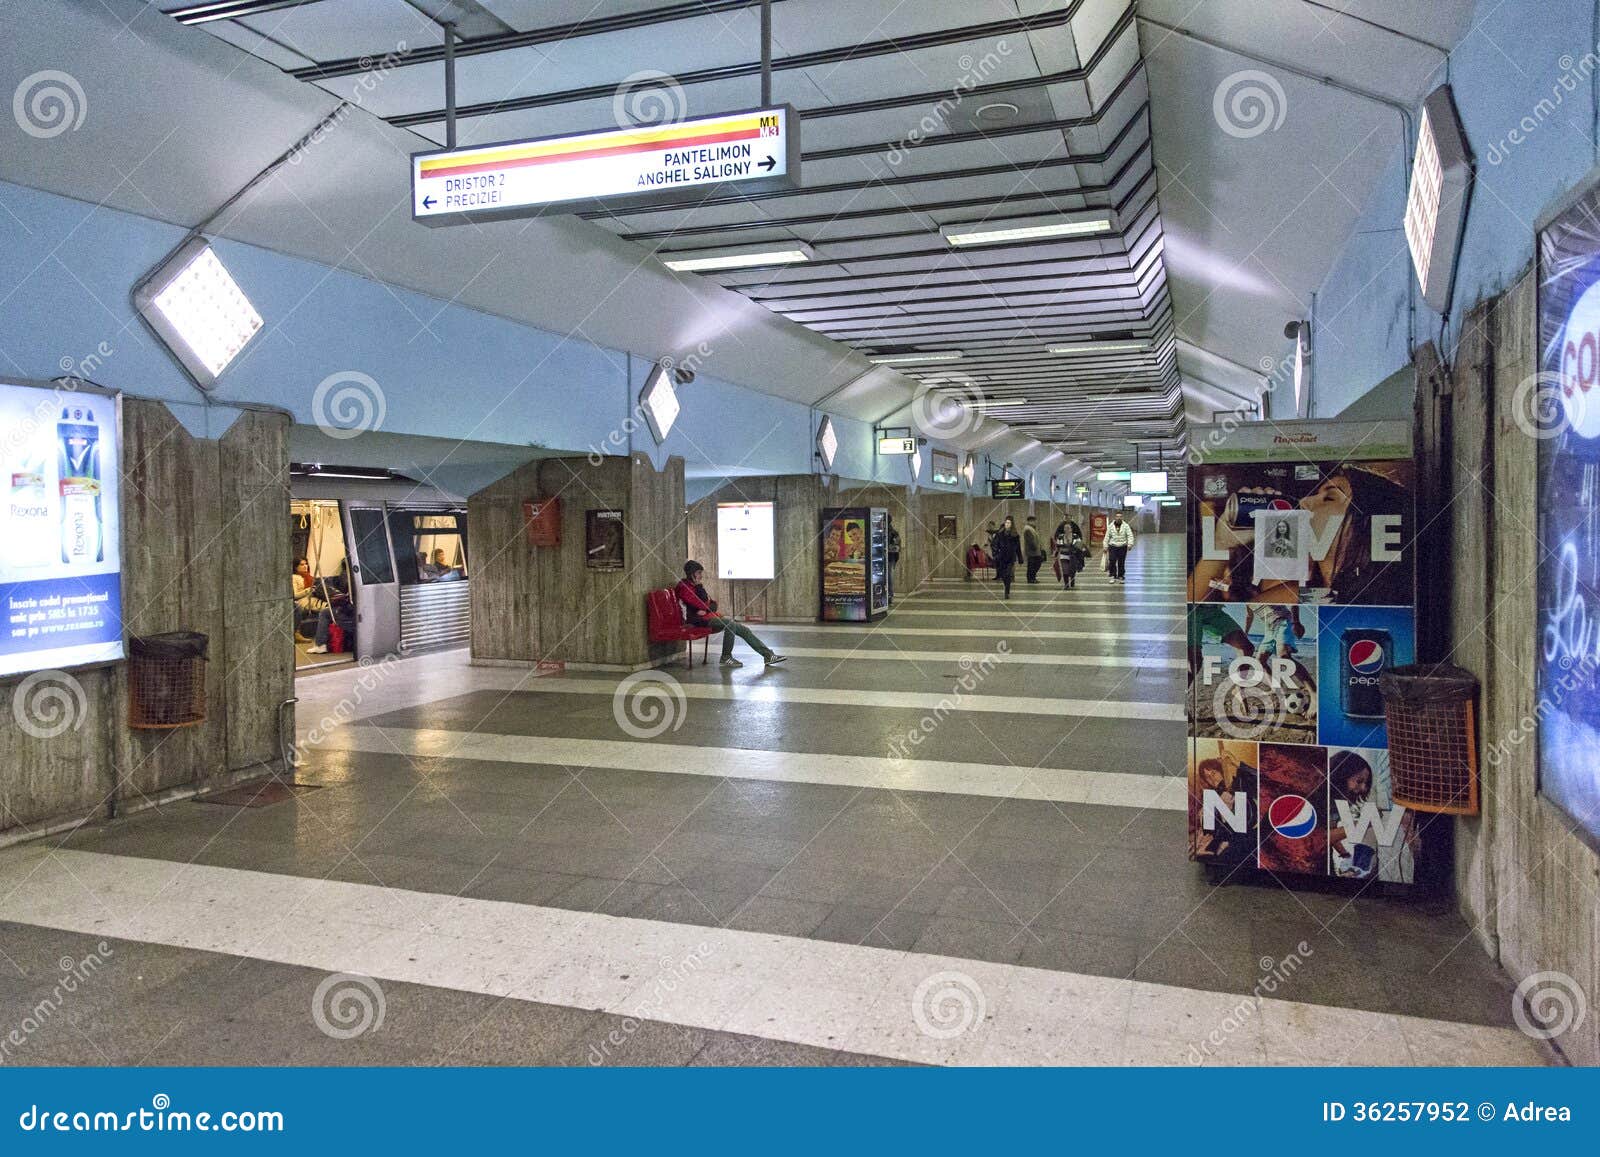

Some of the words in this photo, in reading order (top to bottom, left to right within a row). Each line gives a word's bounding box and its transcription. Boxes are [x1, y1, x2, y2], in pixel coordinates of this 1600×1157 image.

[760, 115, 776, 128] M1
[760, 126, 778, 137] M3
[664, 143, 751, 167] PANTELIMON
[446, 175, 495, 192] DRISTOR
[499, 173, 505, 186] 2
[637, 168, 690, 187] ANGHEL
[694, 160, 751, 180] SALIGNY
[446, 190, 502, 207] PRECIZIEI
[1563, 331, 1600, 399] CO
[1240, 496, 1267, 505] pepsi
[10, 503, 48, 519] Rexona
[72, 511, 87, 557] Rexona
[1202, 514, 1402, 562] LVE
[1203, 655, 1299, 689] FOR
[1350, 676, 1380, 686] peps
